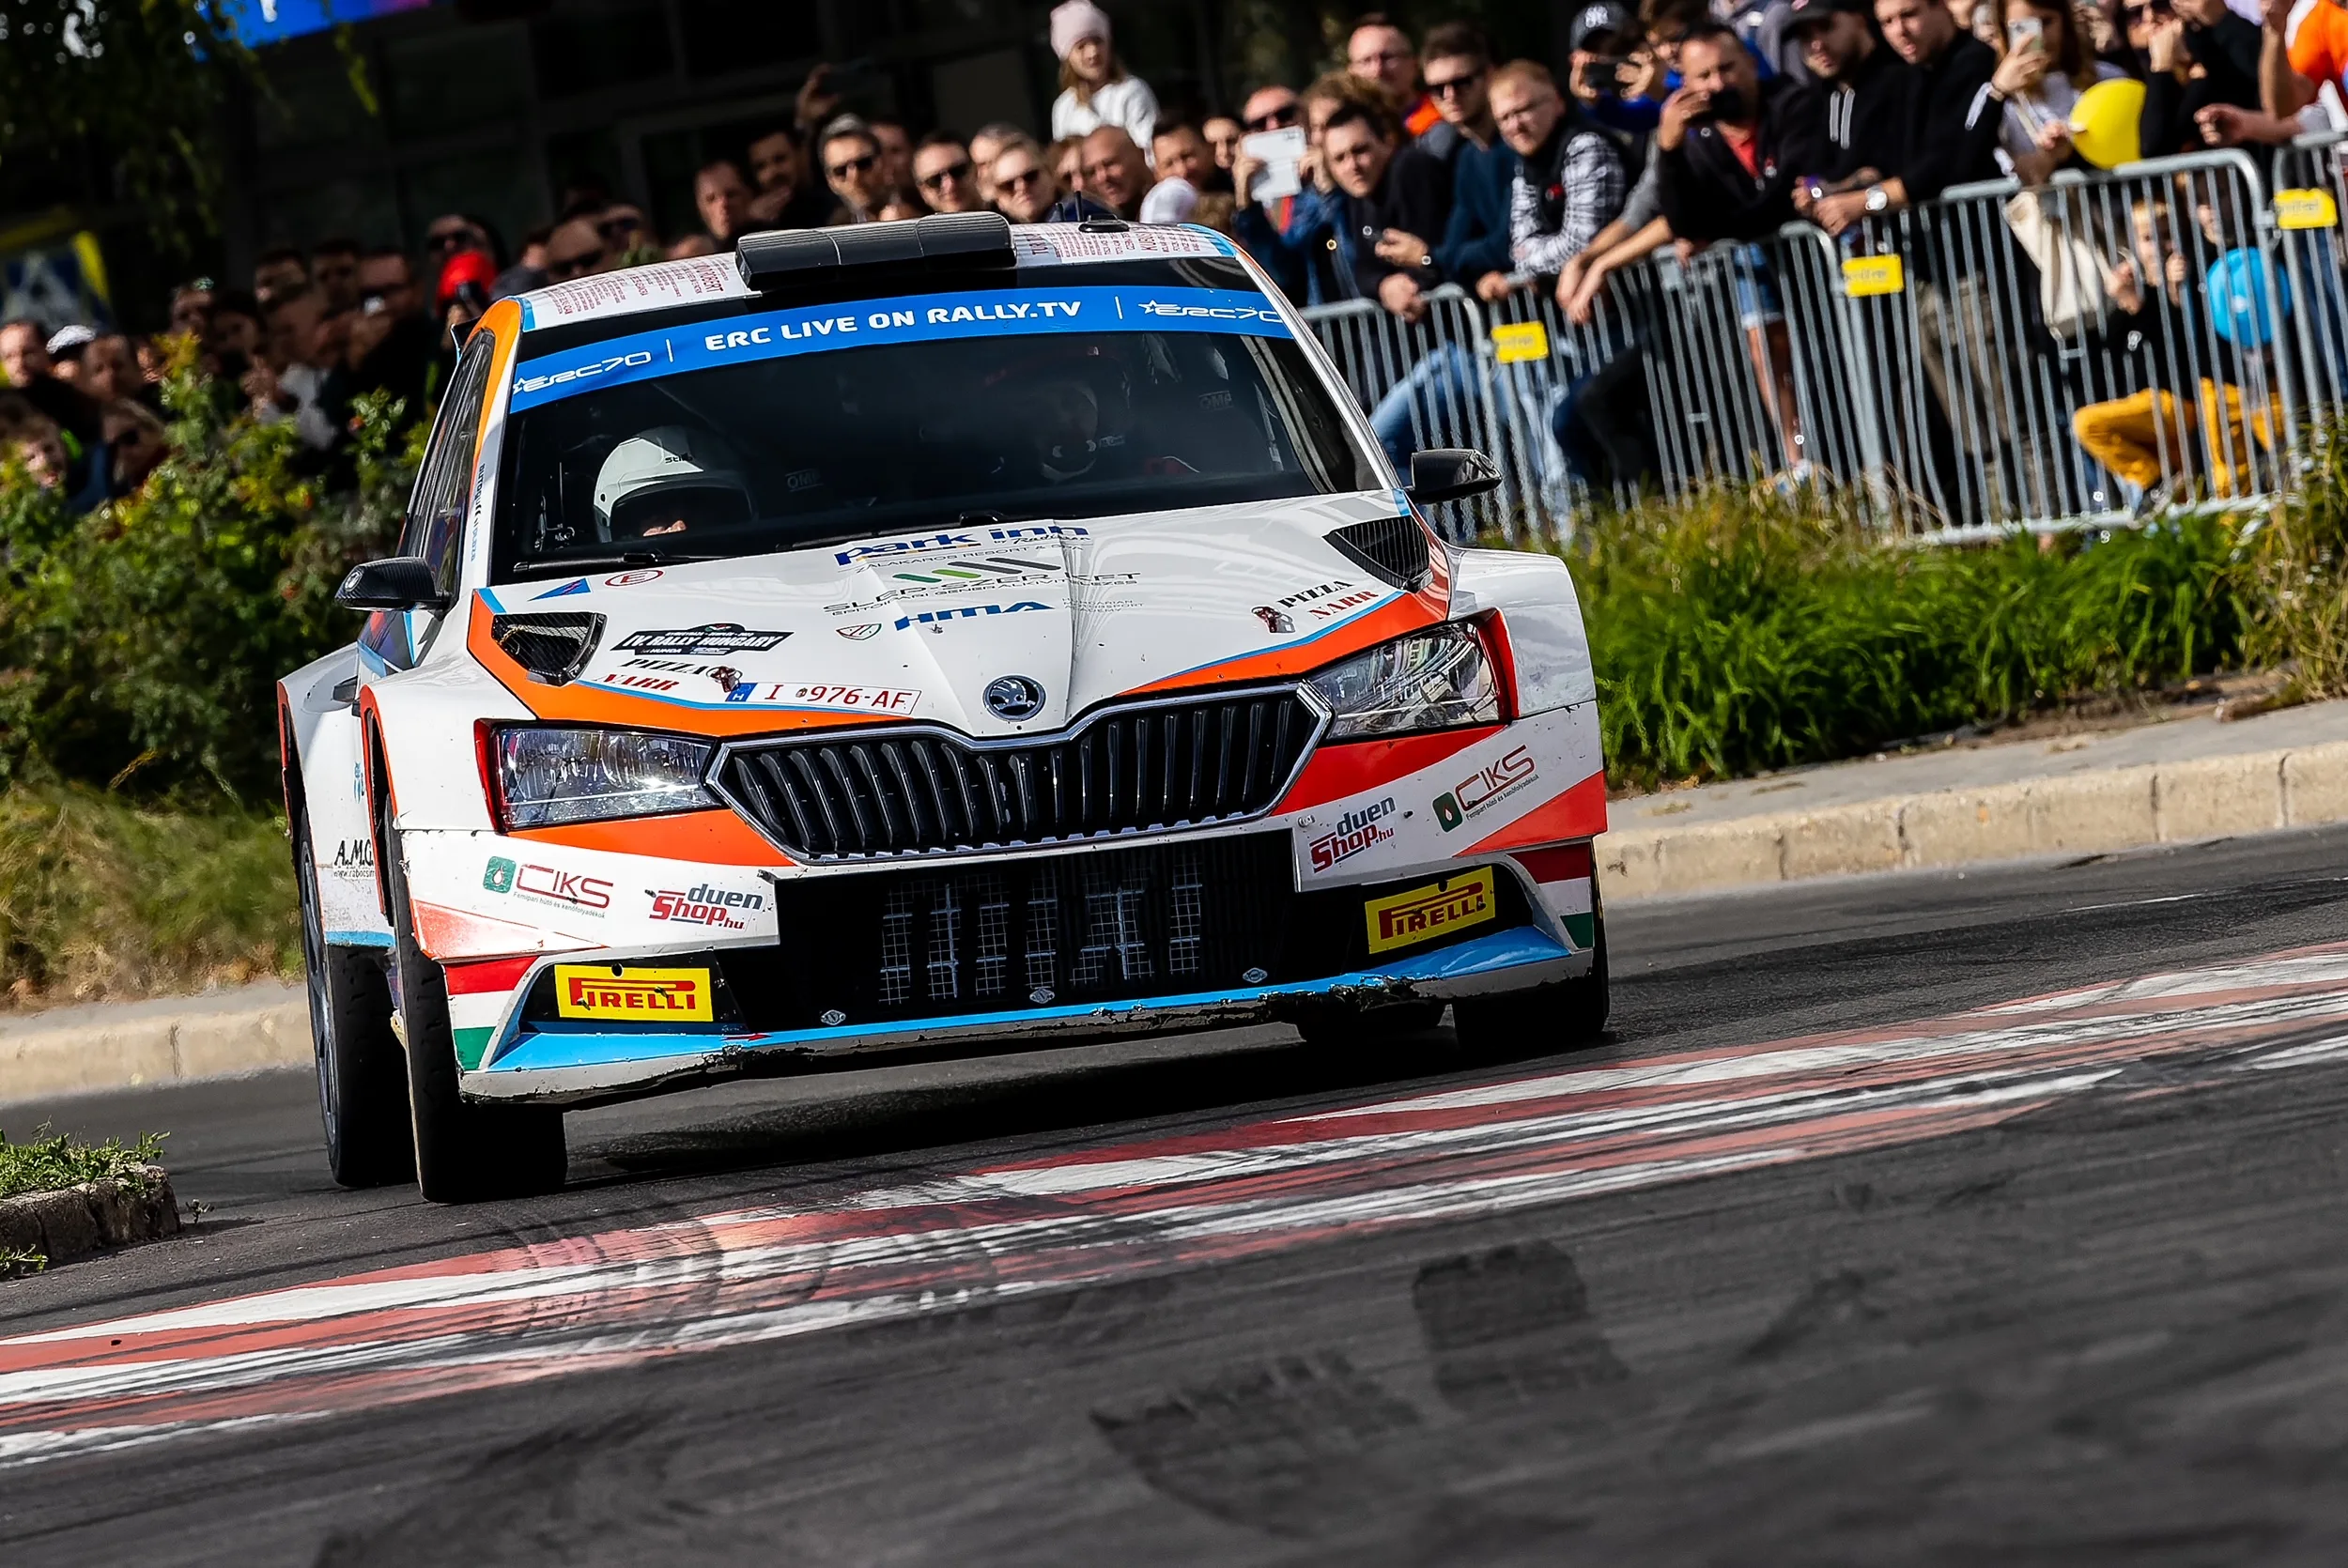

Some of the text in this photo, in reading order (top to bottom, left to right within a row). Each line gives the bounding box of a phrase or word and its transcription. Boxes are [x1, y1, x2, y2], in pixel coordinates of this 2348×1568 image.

[704, 300, 1082, 352] ERC LIVE ON RALLY.TV
[834, 526, 1089, 566] park inn
[856, 554, 958, 573] ZALAKAROS
[963, 546, 1029, 558] RESORT
[1276, 580, 1354, 608] PIZZA
[622, 635, 784, 648] IV. RALLY HUNGARY
[732, 693, 745, 701] H
[1455, 745, 1536, 812] CIKS
[1336, 796, 1397, 838] duen
[516, 863, 614, 909] CIKS
[687, 883, 765, 911] duen
[649, 890, 746, 930] Shop.hu
[1378, 881, 1487, 941] PIRELLI
[567, 976, 696, 1010] PIRELLI
